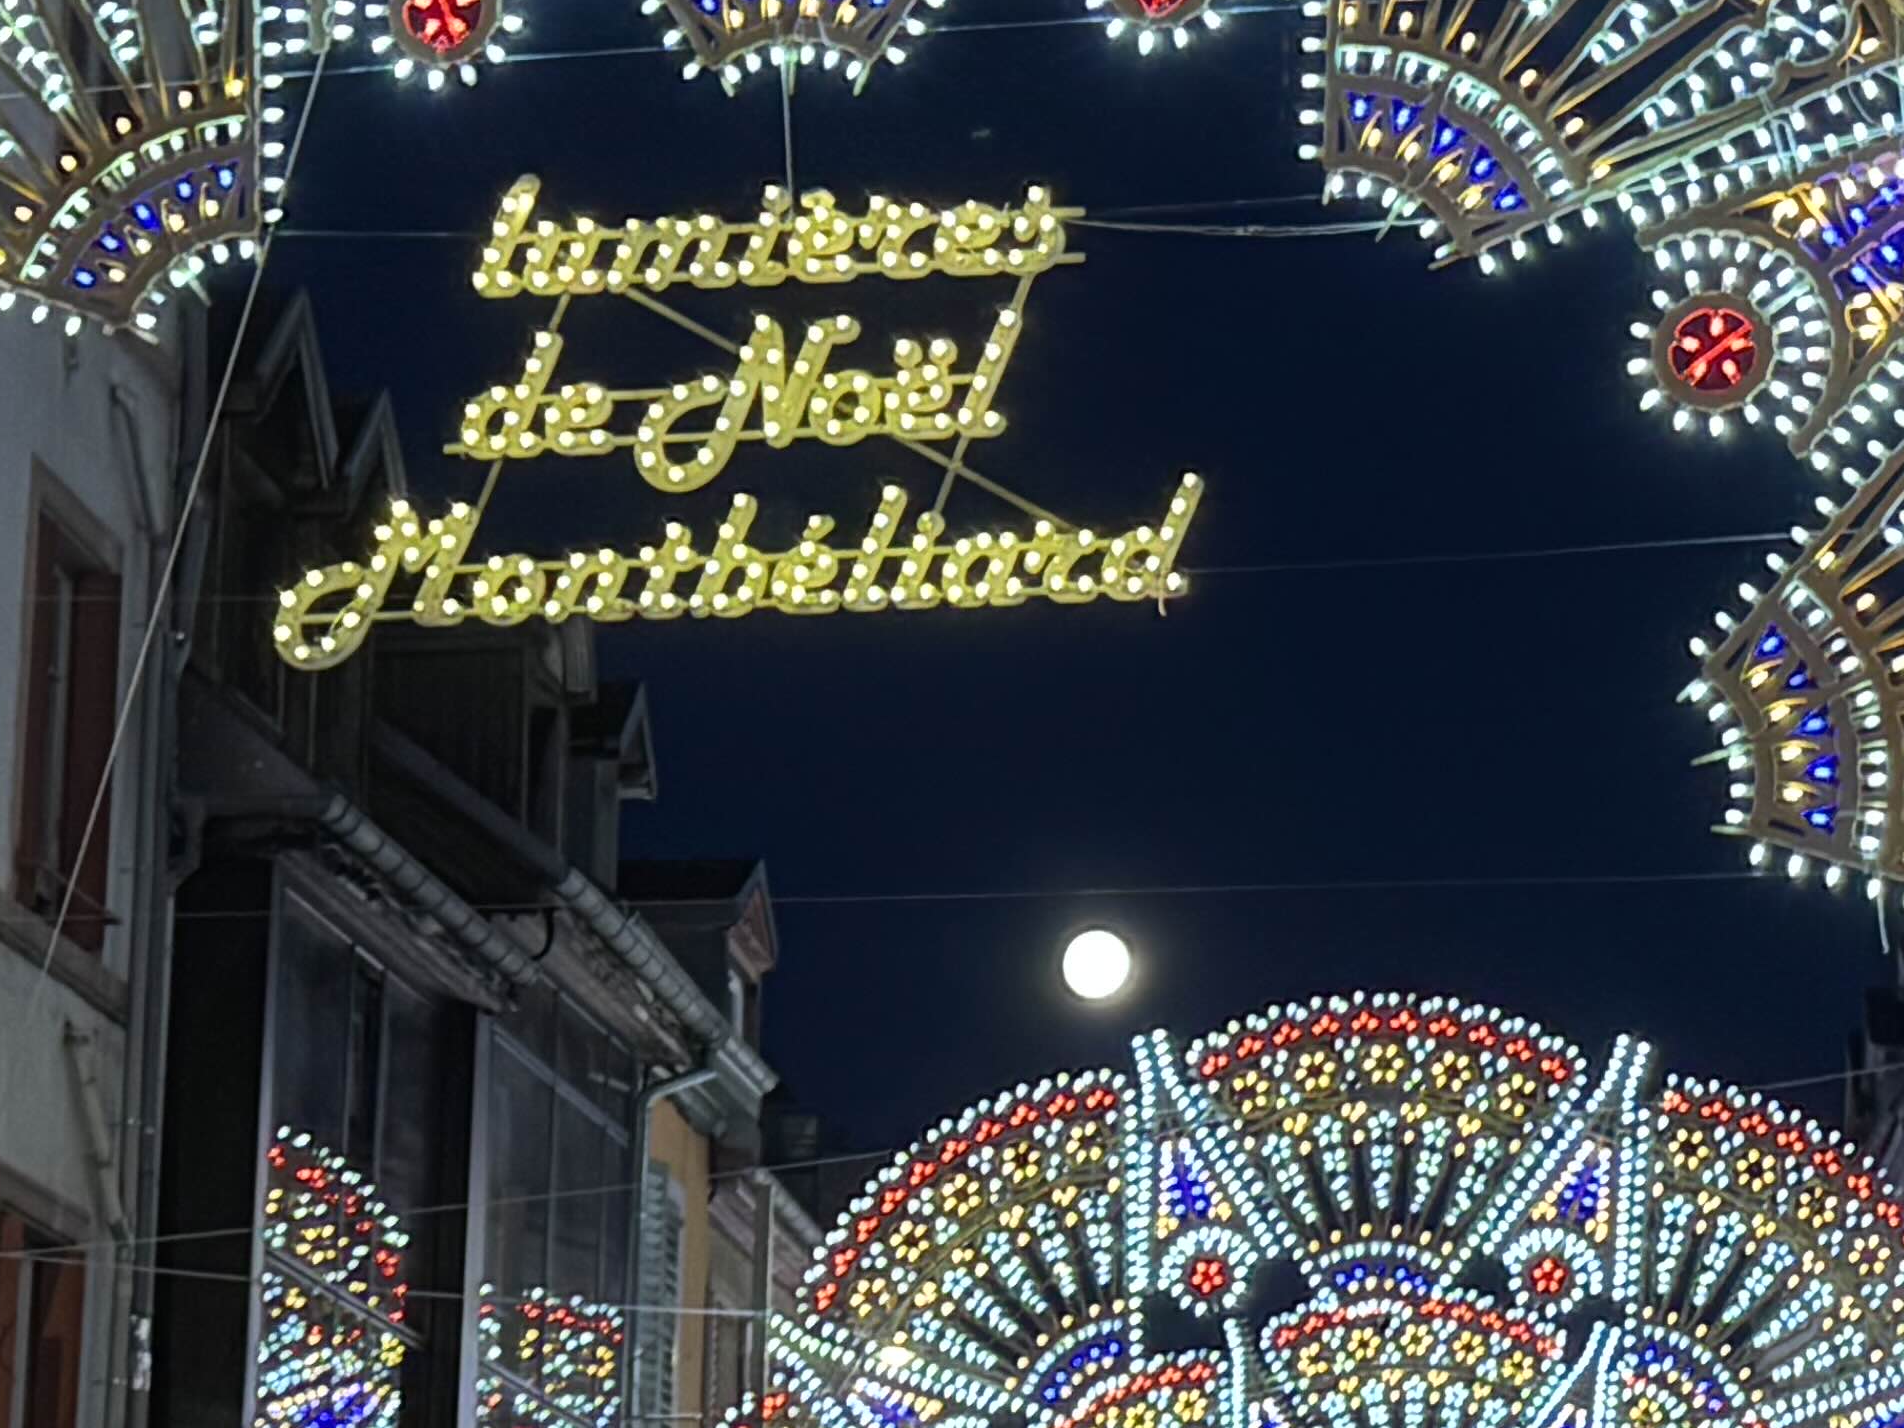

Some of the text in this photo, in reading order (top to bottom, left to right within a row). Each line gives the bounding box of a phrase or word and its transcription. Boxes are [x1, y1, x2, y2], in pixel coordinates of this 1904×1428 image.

[460, 308, 1022, 492] de Noël
[273, 471, 1203, 671] Montbéliard
